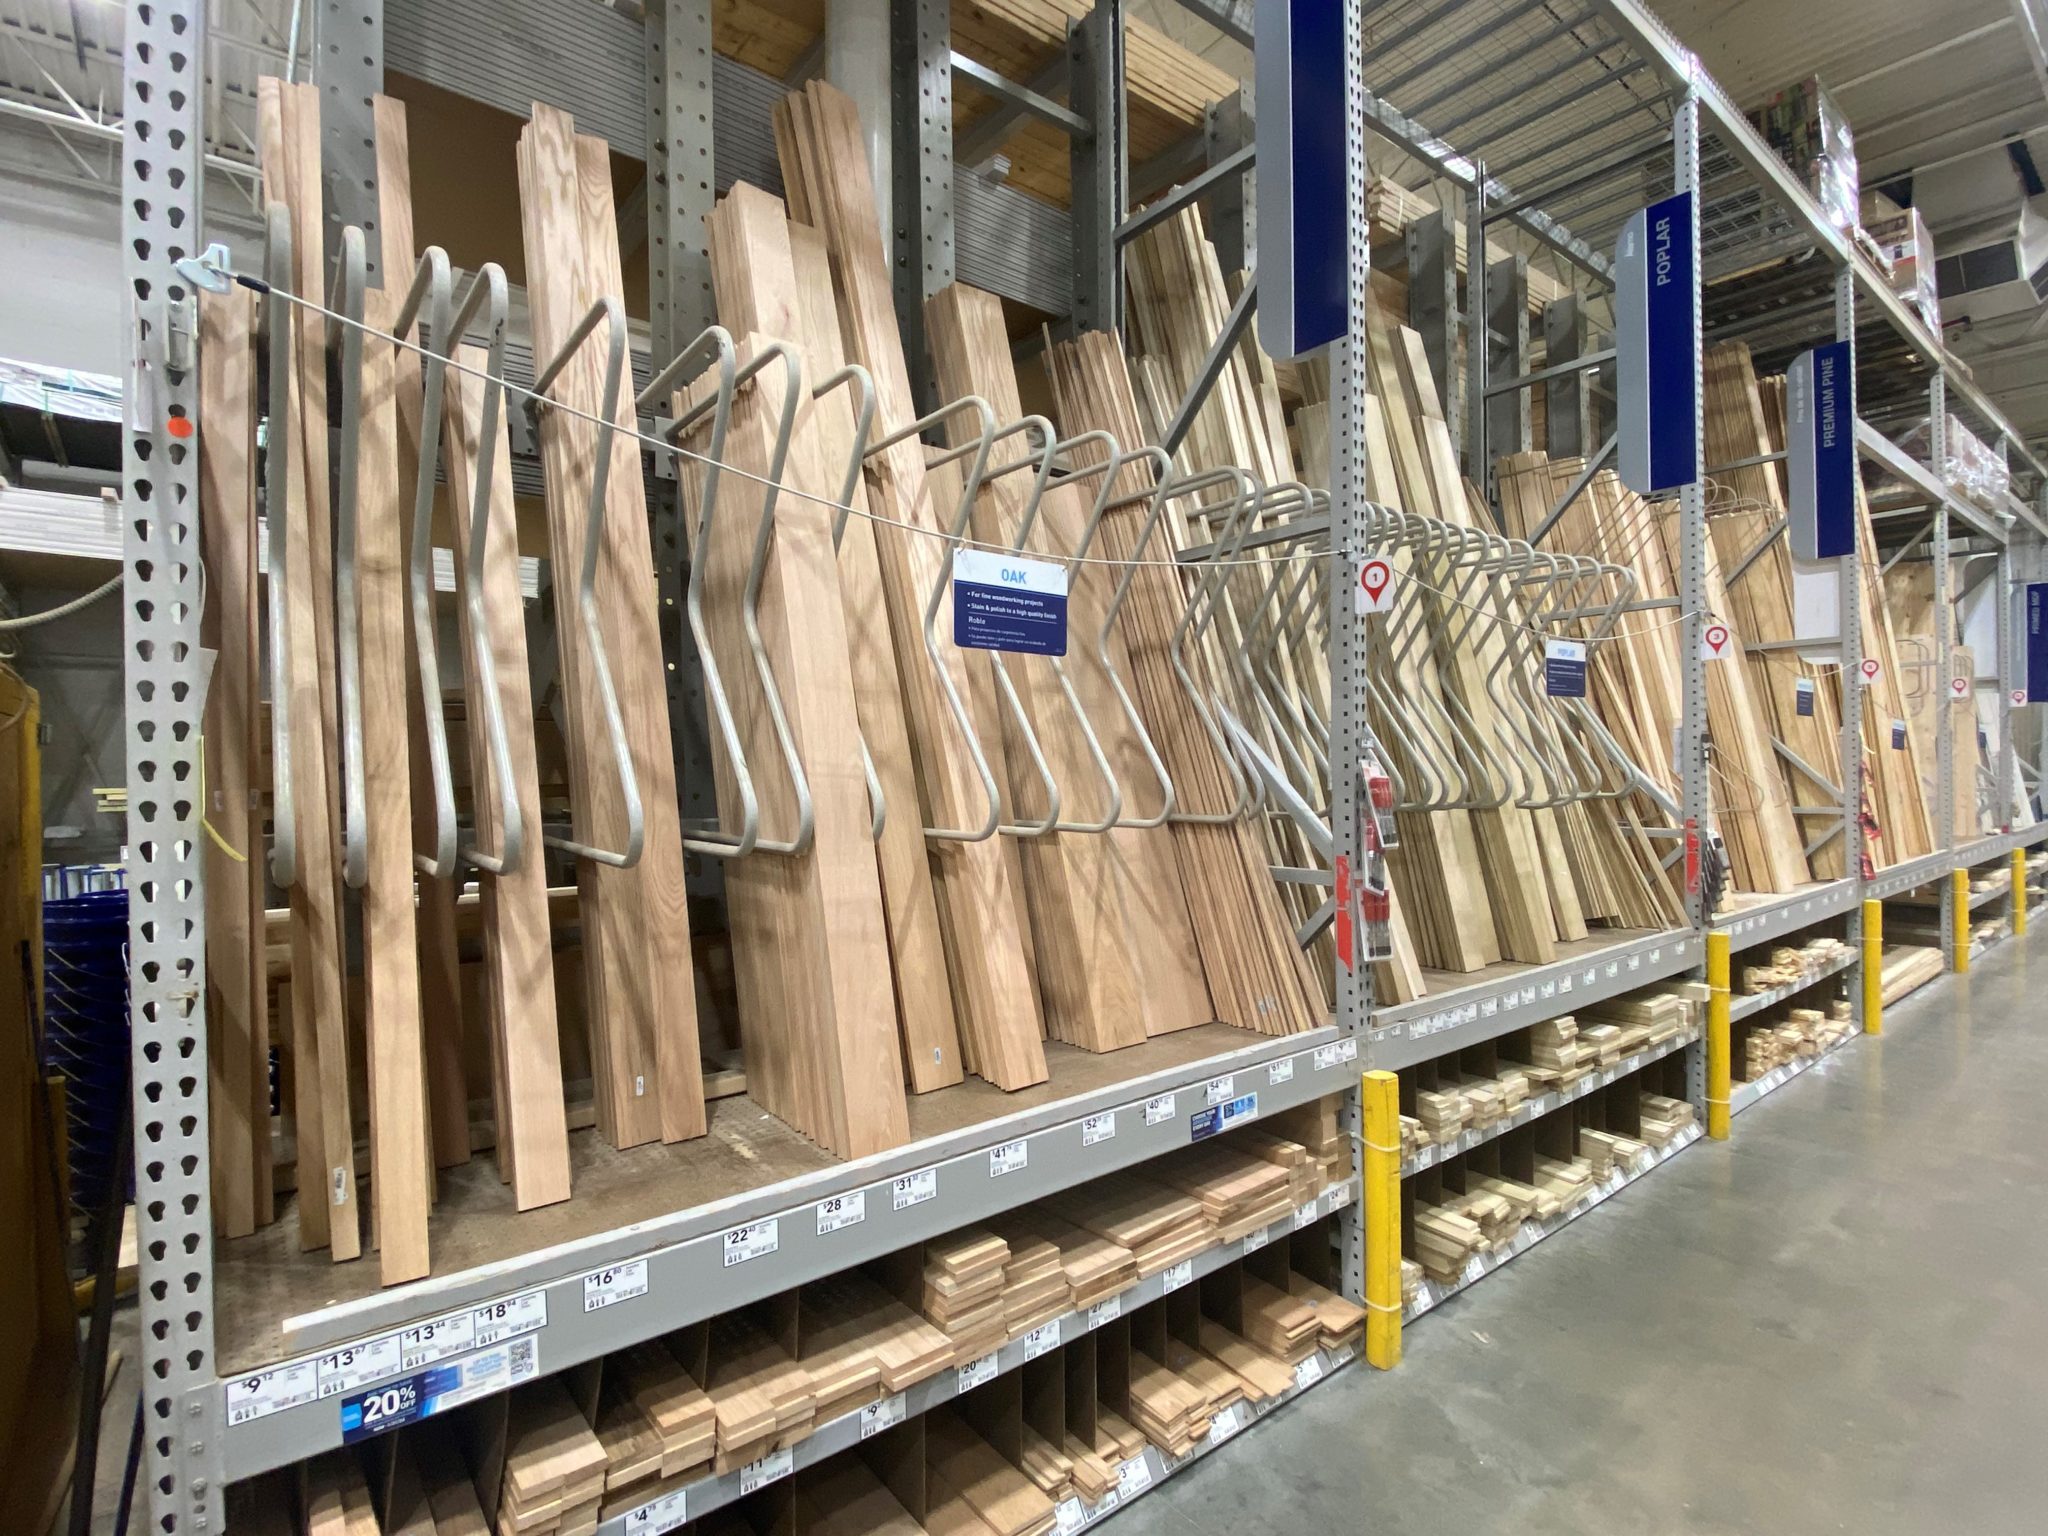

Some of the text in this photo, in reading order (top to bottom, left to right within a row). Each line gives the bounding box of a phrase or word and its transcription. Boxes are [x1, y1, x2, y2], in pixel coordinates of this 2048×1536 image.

[1656, 217, 1671, 286] POPLAR
[1821, 357, 1836, 448] PREMIUM PINE
[1001, 568, 1027, 584] OAK
[1372, 572, 1378, 582] 1
[981, 592, 991, 600] fine
[992, 595, 1024, 605] woodworking
[1024, 599, 1043, 607] projects
[971, 602, 985, 610] Stain
[990, 605, 1006, 613] polish
[1016, 609, 1027, 617] high
[1027, 611, 1044, 619] quality
[968, 616, 986, 625] Roble
[823, 1199, 842, 1213] $28
[400, 1399, 416, 1410] OFF
